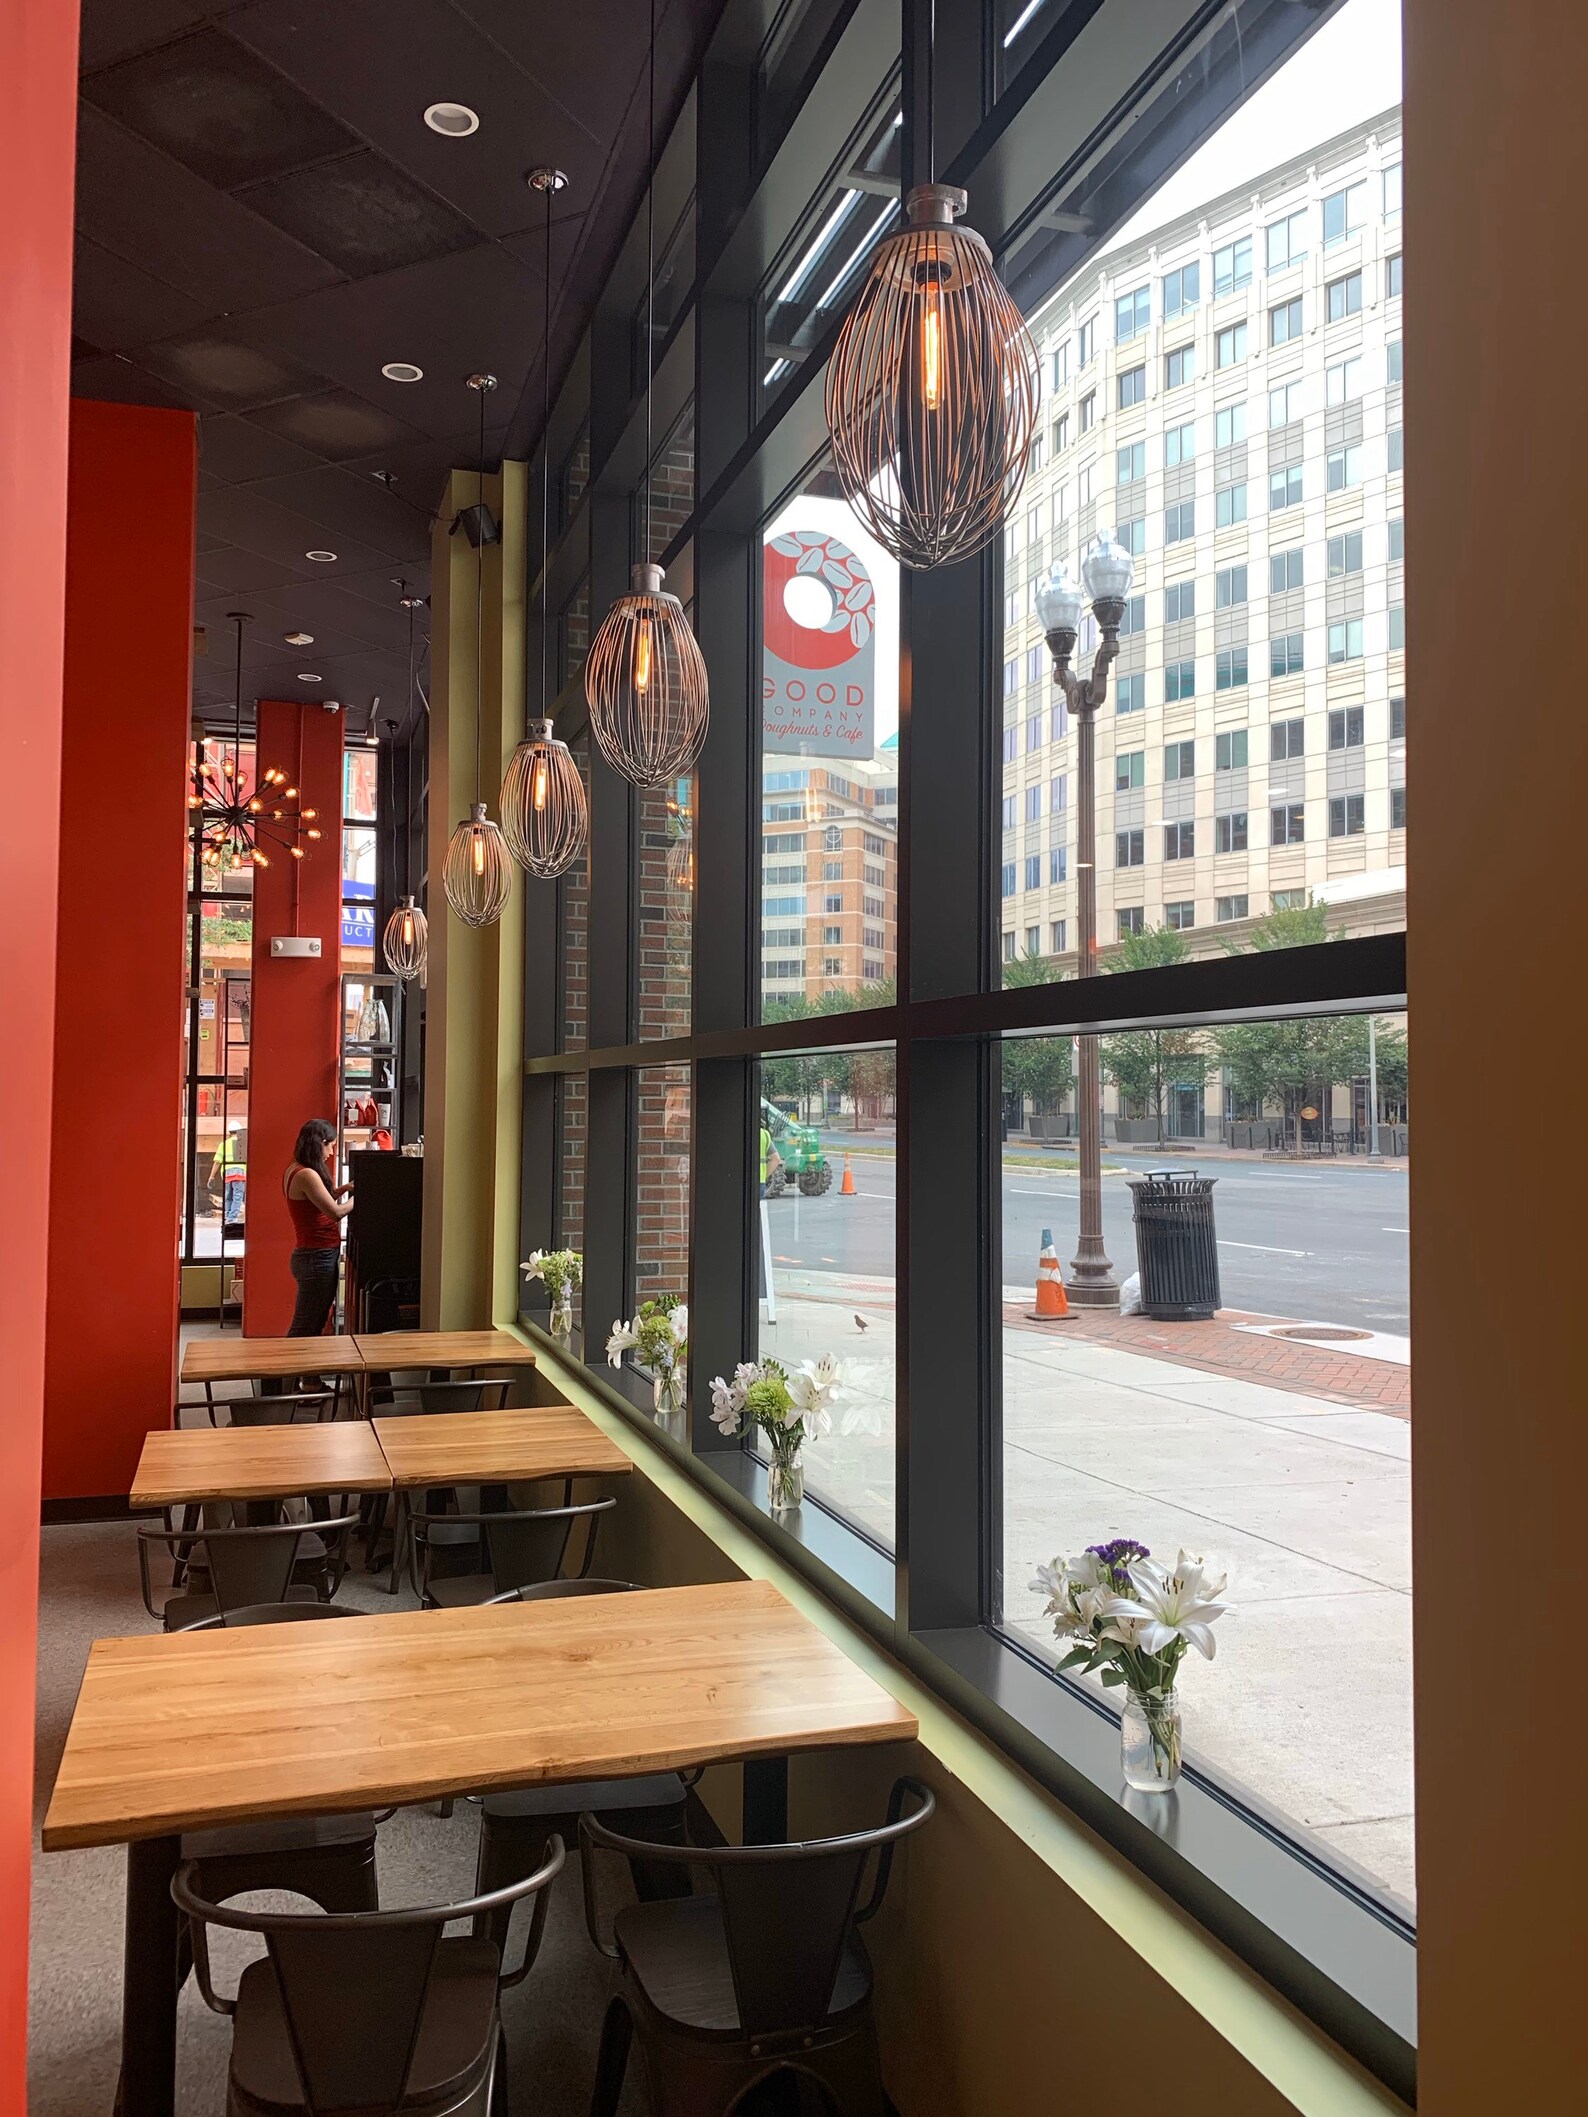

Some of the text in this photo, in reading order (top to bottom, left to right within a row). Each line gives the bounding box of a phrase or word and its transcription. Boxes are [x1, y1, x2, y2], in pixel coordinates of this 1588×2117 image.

[763, 677, 864, 706] GOOD
[763, 704, 863, 722] OMPANY
[823, 724, 833, 738] &
[836, 724, 864, 744] Cafe
